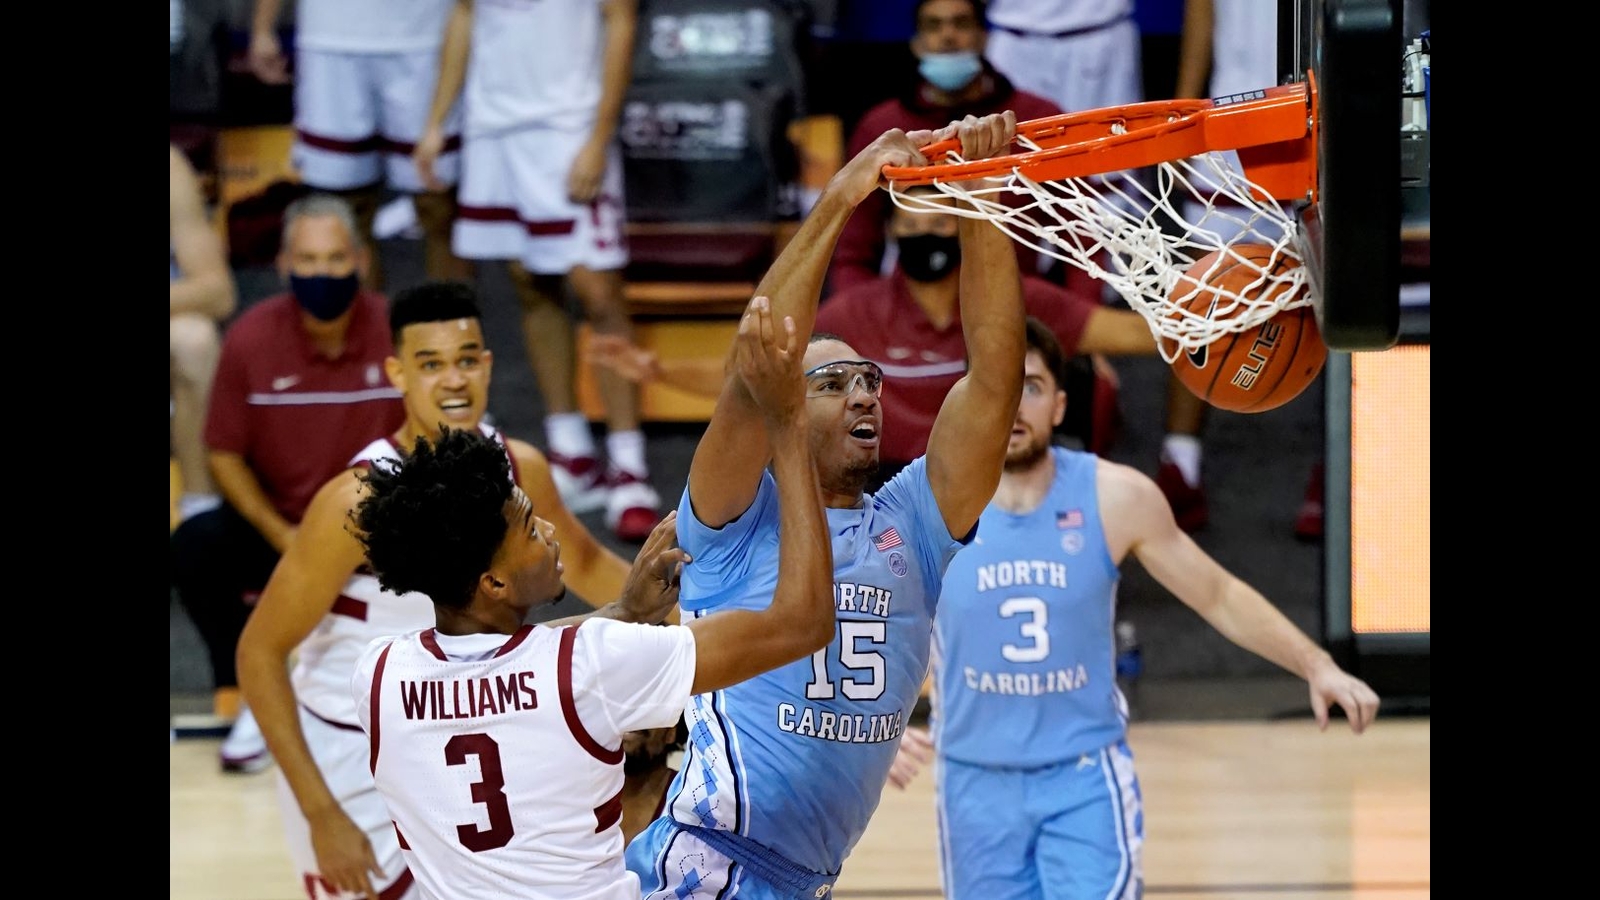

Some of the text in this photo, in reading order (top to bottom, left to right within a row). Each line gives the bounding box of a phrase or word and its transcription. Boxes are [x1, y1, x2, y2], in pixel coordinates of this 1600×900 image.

[1231, 320, 1281, 391] ELITE
[833, 583, 892, 618] RTH
[976, 559, 1068, 592] NORTH
[999, 597, 1050, 662] 3
[805, 620, 887, 702] 15
[963, 664, 1089, 697] CAROLINA
[401, 670, 539, 721] WILLIAMS
[777, 702, 902, 744] CAROLINA
[444, 733, 515, 853] 3
